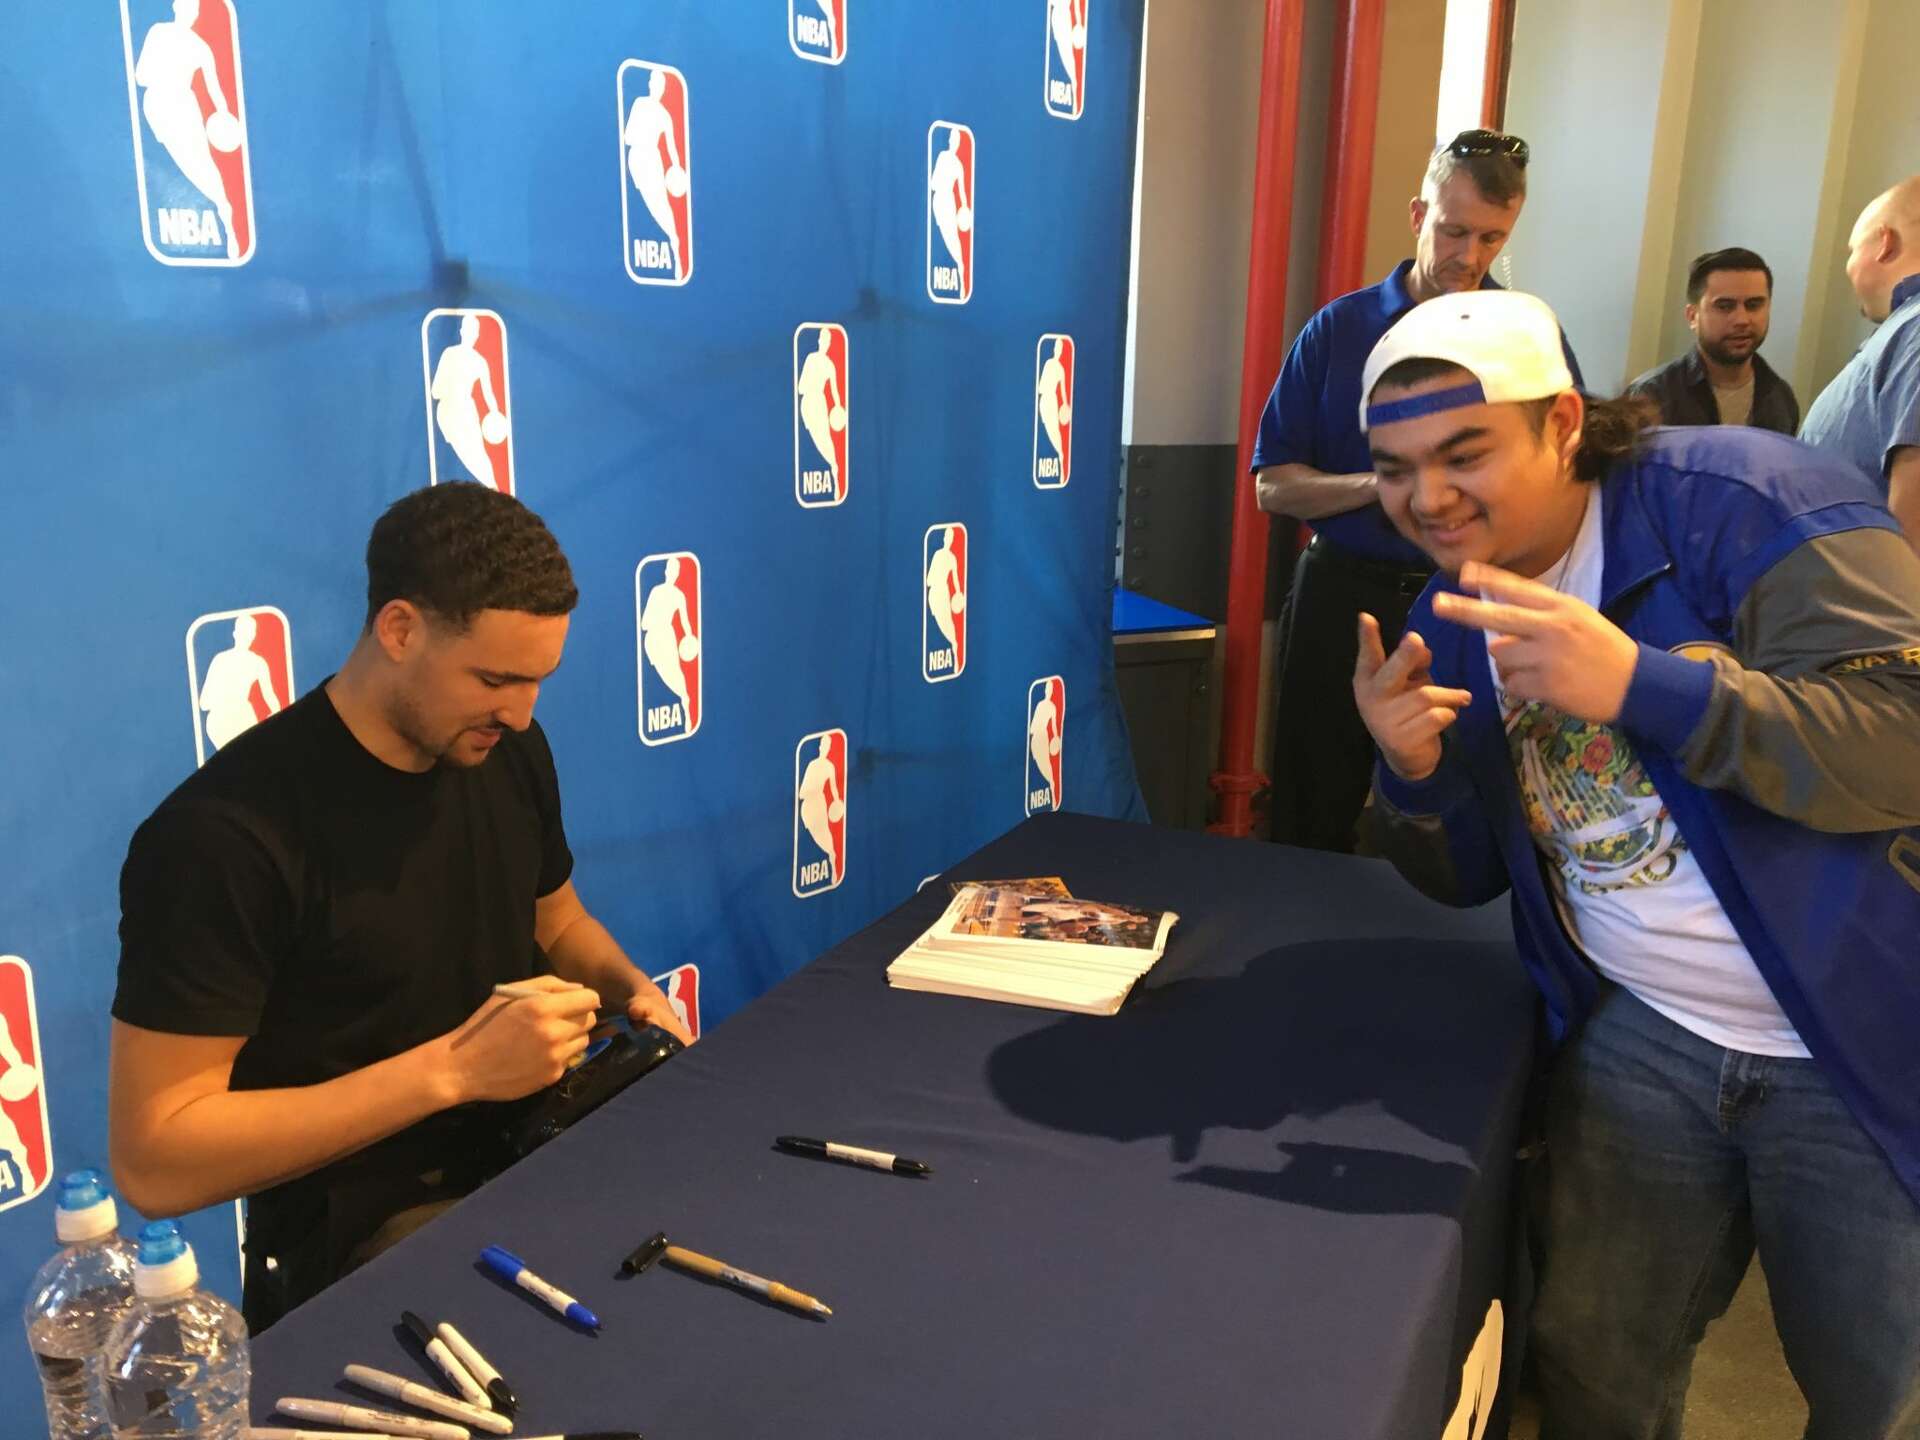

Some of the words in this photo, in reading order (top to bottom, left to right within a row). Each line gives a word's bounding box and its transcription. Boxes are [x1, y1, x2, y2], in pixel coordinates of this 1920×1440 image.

[797, 15, 829, 48] NBA
[1050, 79, 1072, 106] NBA
[157, 207, 222, 246] NBA
[634, 239, 672, 270] NBA
[934, 266, 959, 291] NBA
[1038, 457, 1060, 478] NBA
[803, 470, 832, 495] NBA
[929, 648, 953, 671] NBA
[648, 703, 682, 732] NBA
[1030, 787, 1050, 809] NBA
[801, 859, 829, 886] NBA
